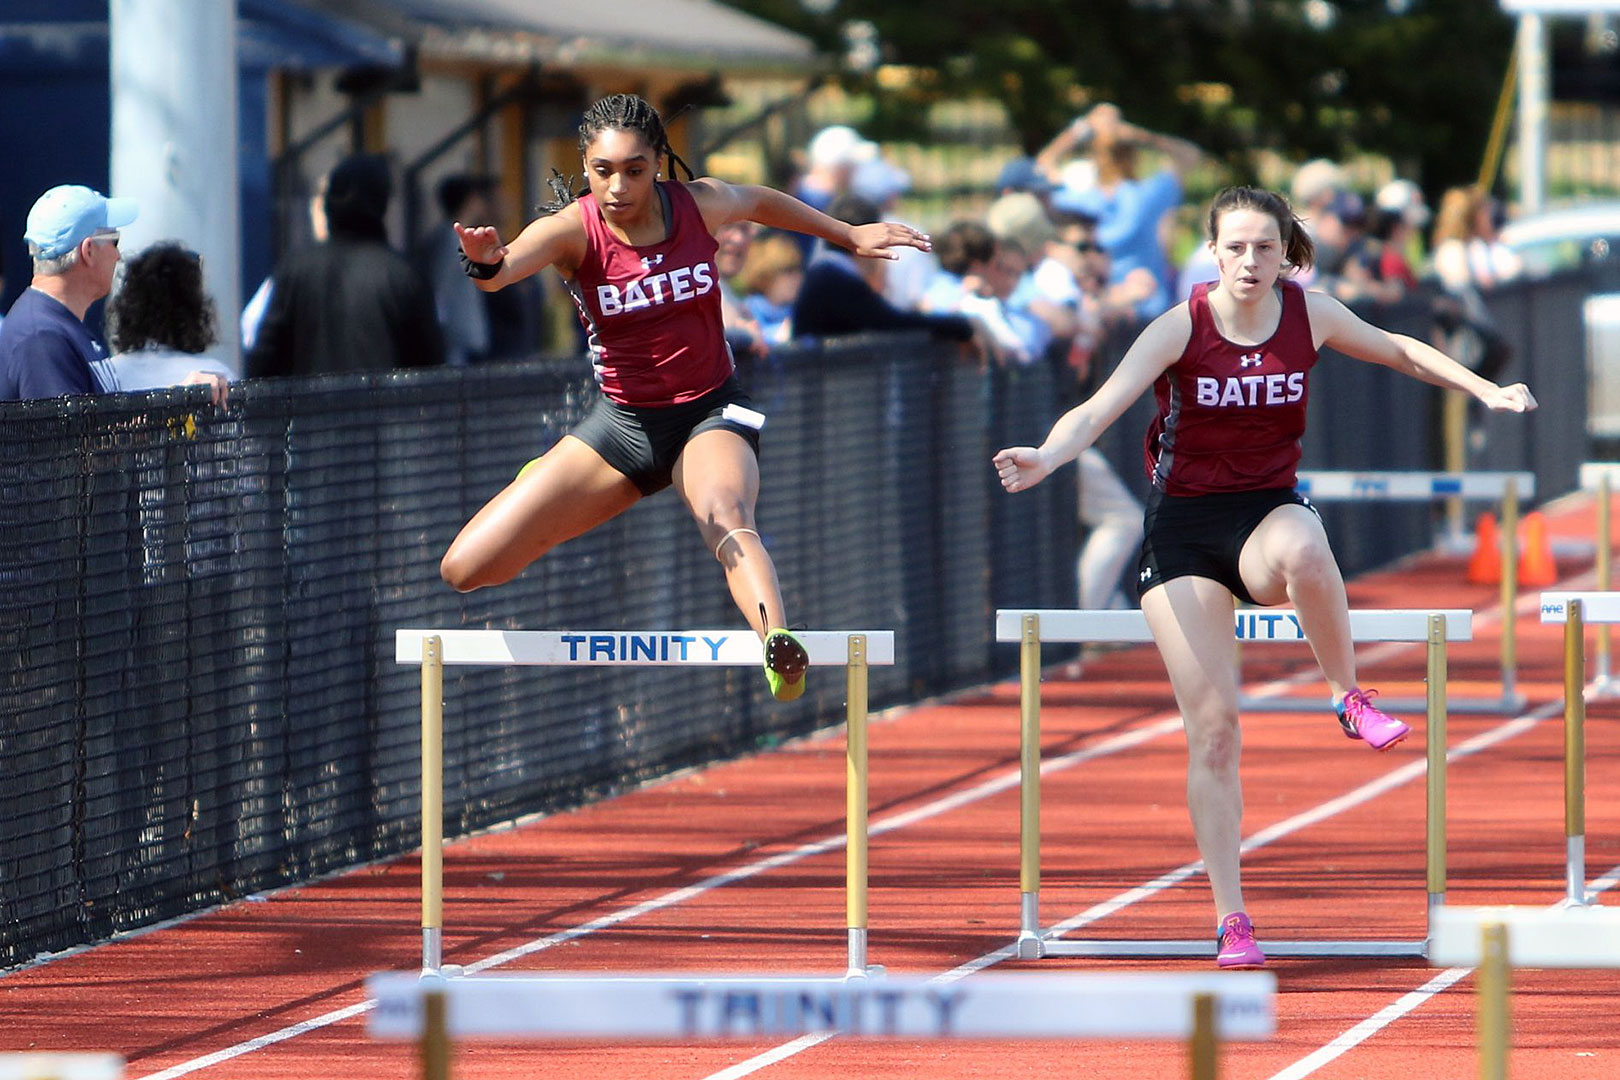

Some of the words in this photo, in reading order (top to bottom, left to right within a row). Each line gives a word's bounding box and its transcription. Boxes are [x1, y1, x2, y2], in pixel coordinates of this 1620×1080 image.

[597, 262, 713, 316] BATES
[1197, 372, 1304, 406] BATES
[561, 635, 728, 661] TRINITY
[670, 989, 967, 1036] TRINITY
